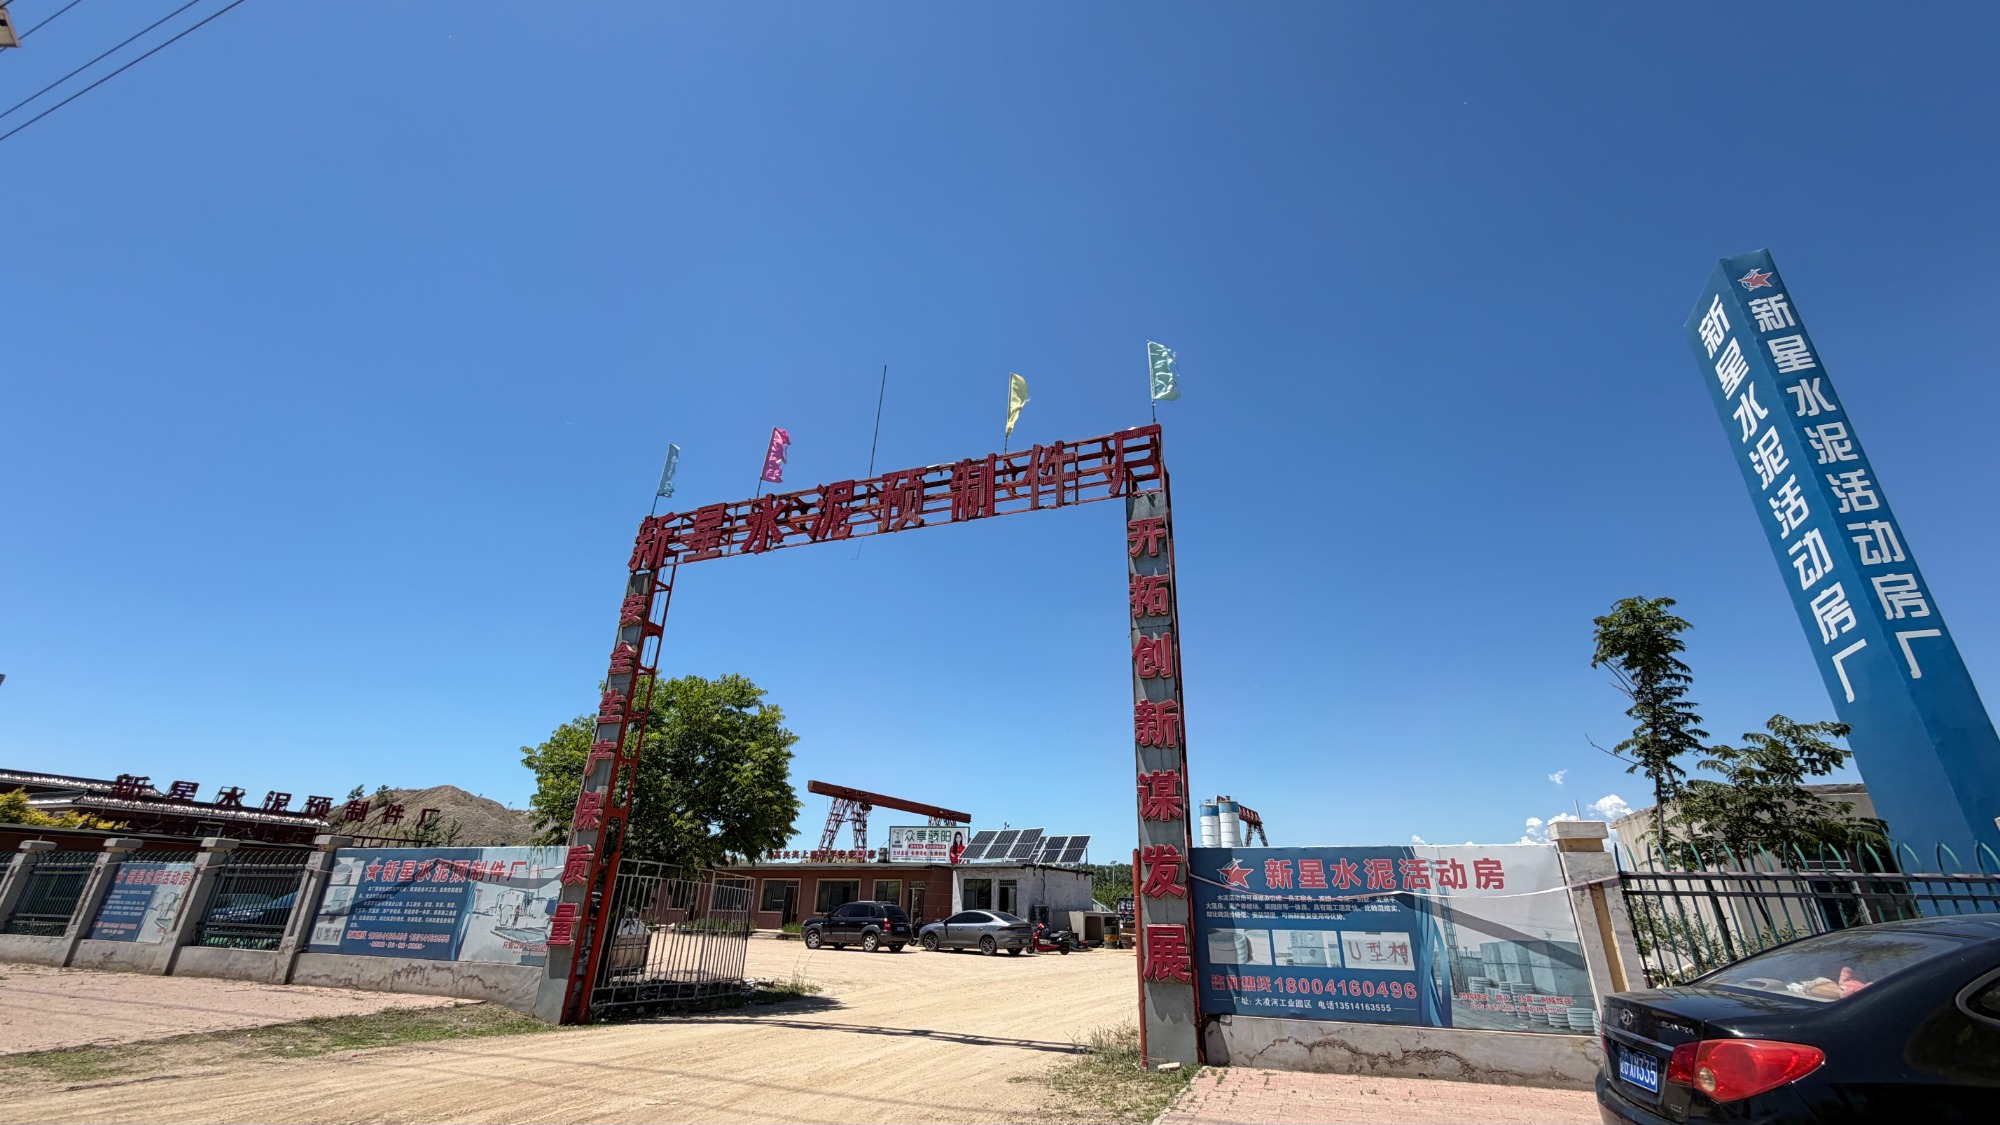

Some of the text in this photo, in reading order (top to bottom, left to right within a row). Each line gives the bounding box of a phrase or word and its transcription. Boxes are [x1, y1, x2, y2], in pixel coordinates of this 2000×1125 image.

[627, 424, 1162, 571] 新星水泥预制件厂
[1698, 294, 1868, 704] 新星水泥活动房厂
[1747, 293, 1942, 680] 新星水泥活动房厂
[546, 592, 649, 947] 安全生产保质量
[1127, 516, 1193, 986] 开拓创新谋发展
[111, 773, 441, 827] 新星水泥预制件厂
[904, 829, 952, 844] 众享骄阳
[125, 868, 192, 886] 新星水泥活动房
[381, 859, 527, 883] 新星水泥预制件厂
[1265, 858, 1506, 890] 新星水泥活动房
[1210, 974, 1418, 999] 咨询热线 18004160496
[1317, 1000, 1392, 1012] 电话13514163555
